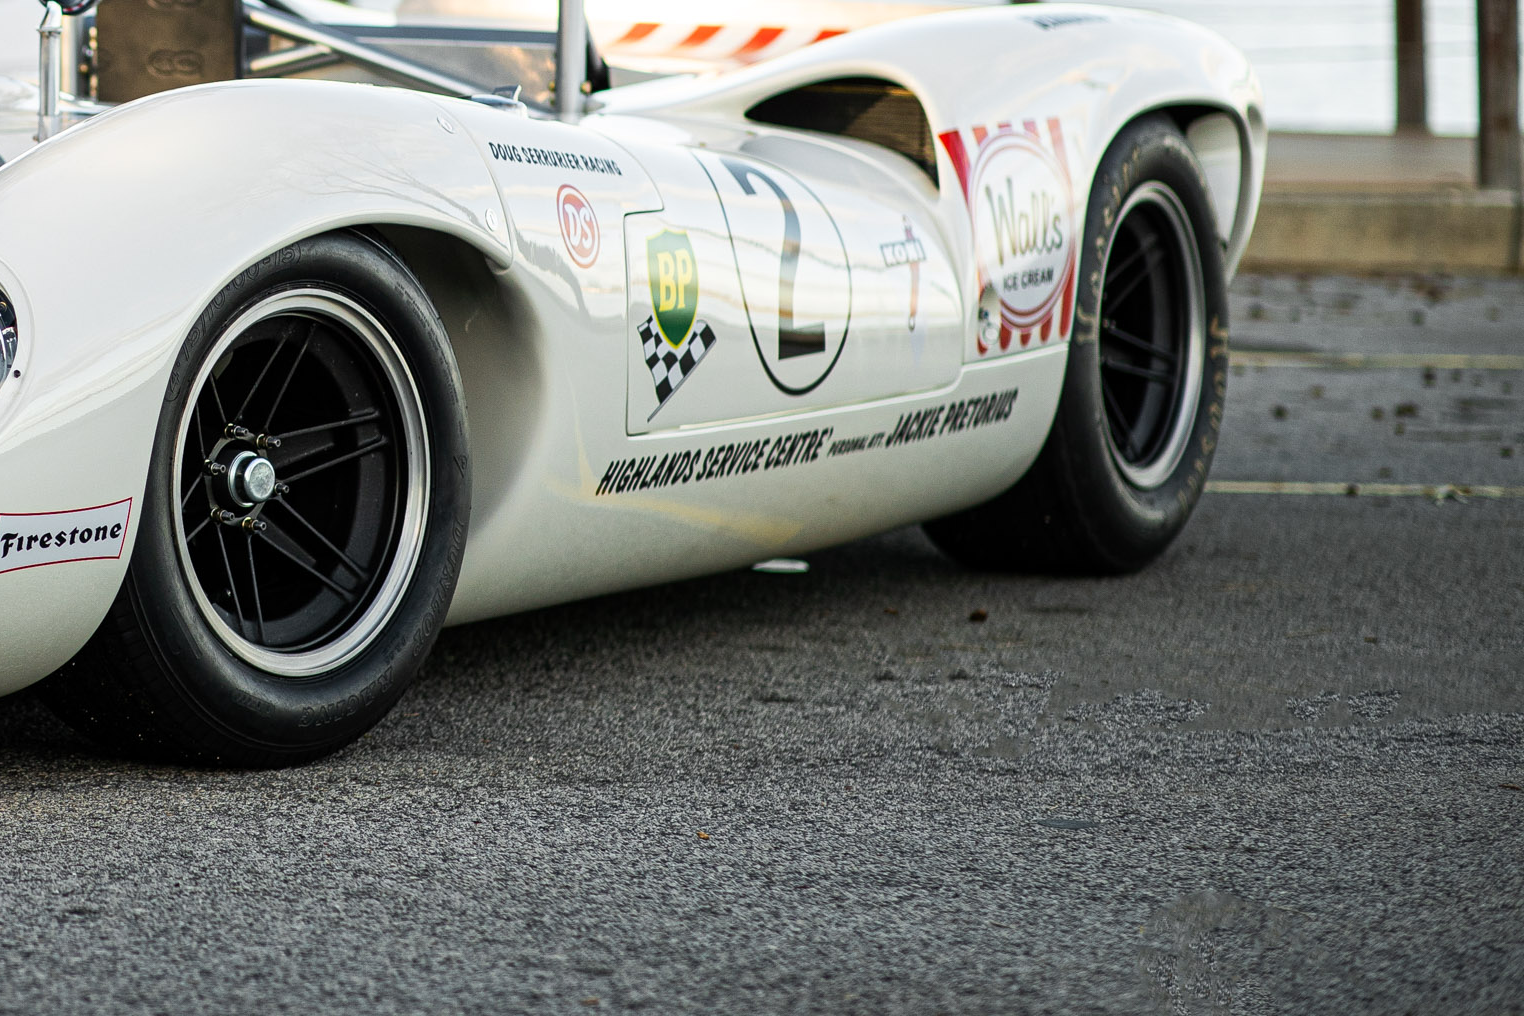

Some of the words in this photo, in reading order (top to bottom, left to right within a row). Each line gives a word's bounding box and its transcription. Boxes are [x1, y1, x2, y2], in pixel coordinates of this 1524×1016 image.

[488, 141, 523, 163] DOUG
[521, 146, 583, 171] SERRURIER
[580, 154, 622, 176] RACING
[563, 203, 593, 249] DS
[657, 248, 693, 313] BP
[719, 156, 826, 361] 2
[1003, 272, 1019, 292] ICE
[1019, 267, 1055, 290] CREAM
[595, 448, 702, 497] HIGHLANDS
[696, 437, 771, 482] SERVICE
[885, 405, 946, 449] JACKIE
[939, 387, 1019, 436] PRETORIUS
[0, 522, 123, 559] Firestone
[298, 666, 395, 728] RACING
